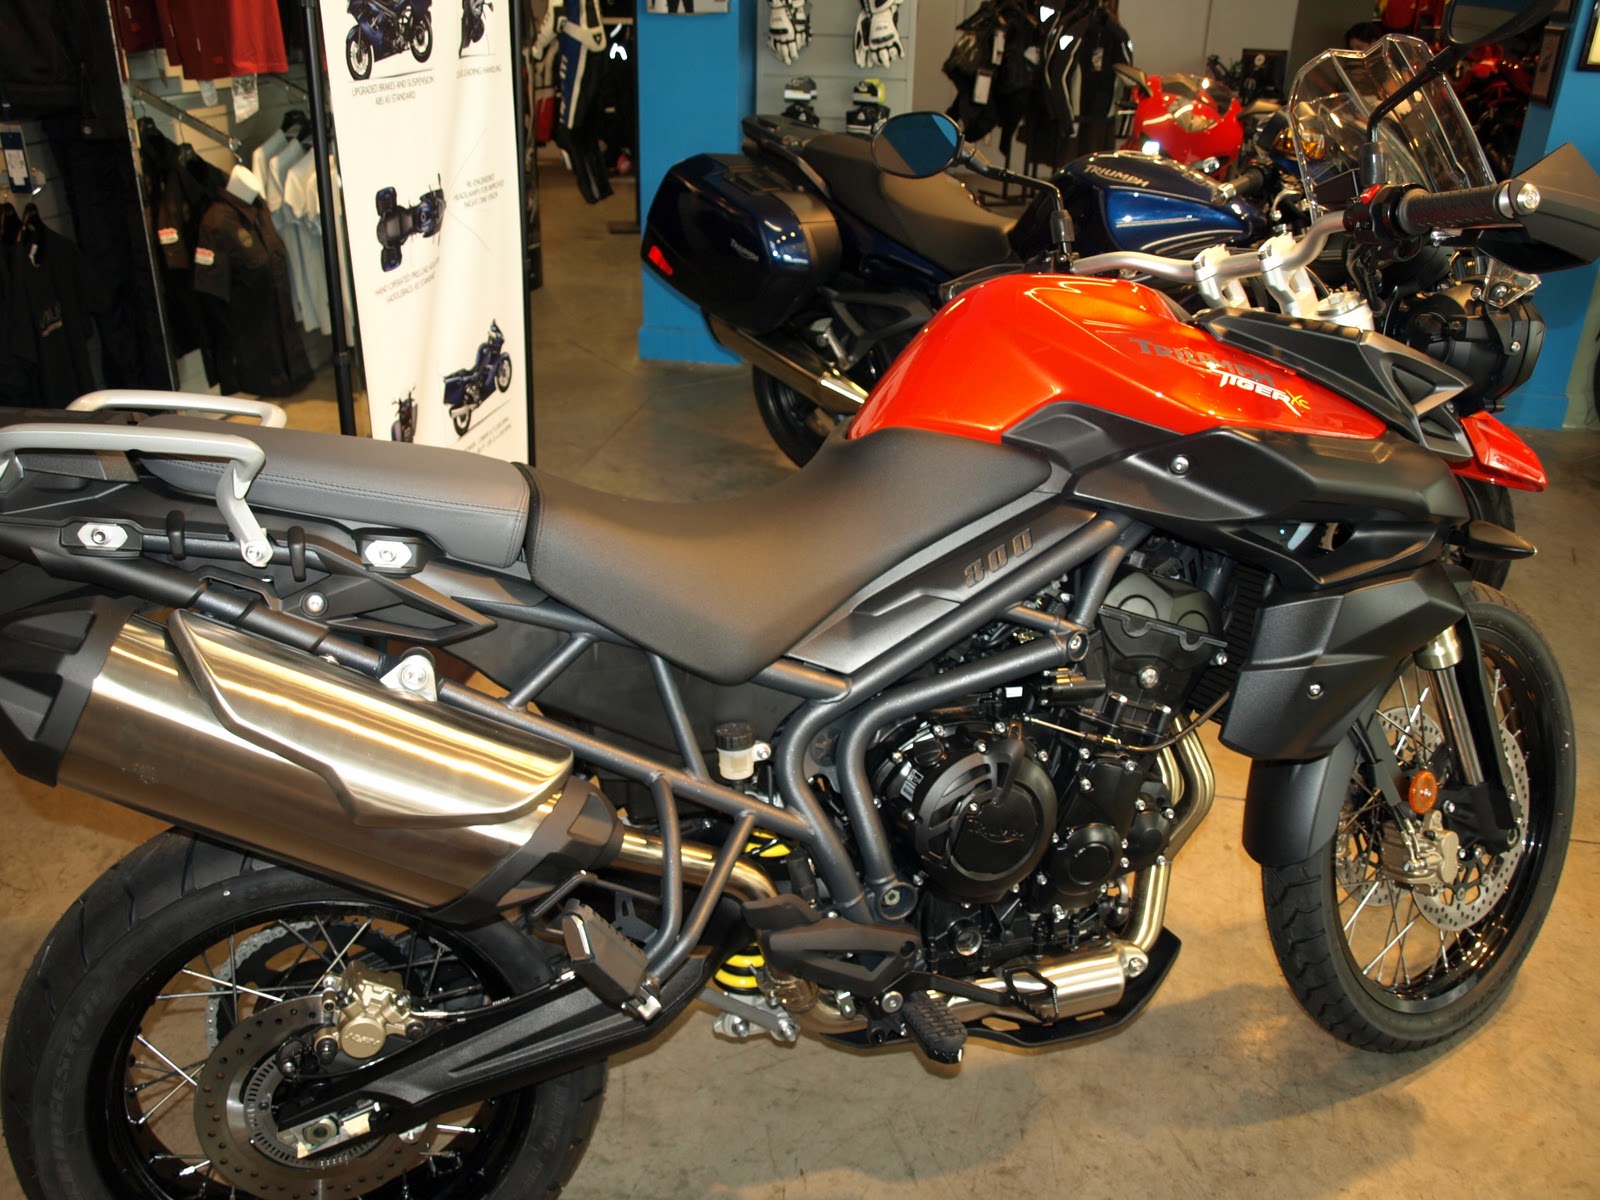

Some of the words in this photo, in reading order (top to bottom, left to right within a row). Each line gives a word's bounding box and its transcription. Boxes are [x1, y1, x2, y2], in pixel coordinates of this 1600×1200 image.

[352, 84, 378, 97] UPGRADED
[379, 81, 395, 92] BRAKES
[396, 79, 406, 89] AND
[407, 76, 435, 87] SUSPENSION
[375, 96, 384, 105] ABS
[385, 95, 391, 104] AS
[391, 90, 416, 103] STANDARD
[1083, 164, 1150, 188] TRIUMPH
[1129, 337, 1275, 387] TRIUMPH
[1211, 368, 1302, 417] TIGER
[964, 528, 1033, 588] 800
